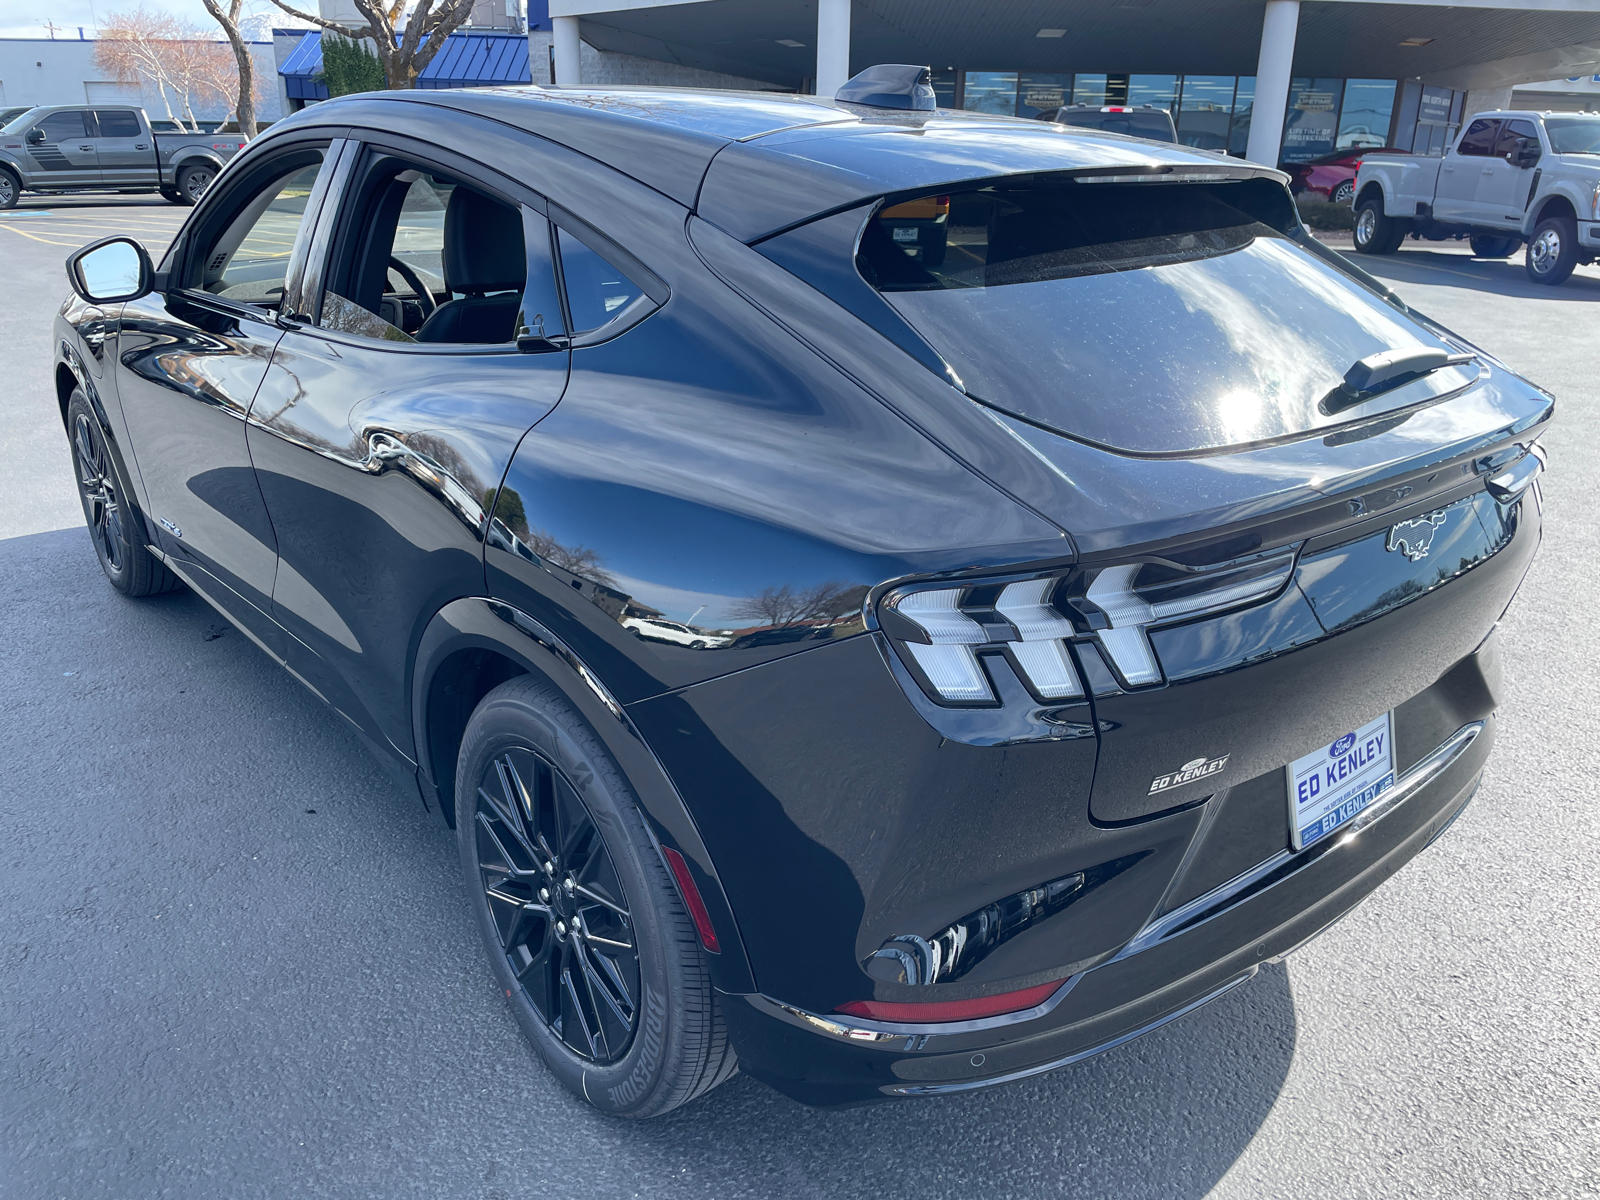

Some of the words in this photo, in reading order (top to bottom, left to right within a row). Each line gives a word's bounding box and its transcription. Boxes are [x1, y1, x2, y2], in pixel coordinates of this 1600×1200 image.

[1150, 777, 1170, 791] ED
[1173, 757, 1228, 784] KENLEY
[1298, 773, 1320, 804] ED
[1326, 732, 1384, 787] KENLEY
[1322, 812, 1336, 832] ED
[1339, 785, 1377, 820] KENLEY
[1330, 795, 1343, 808] SOFTER
[607, 982, 666, 1108] BRIDGESTONE
